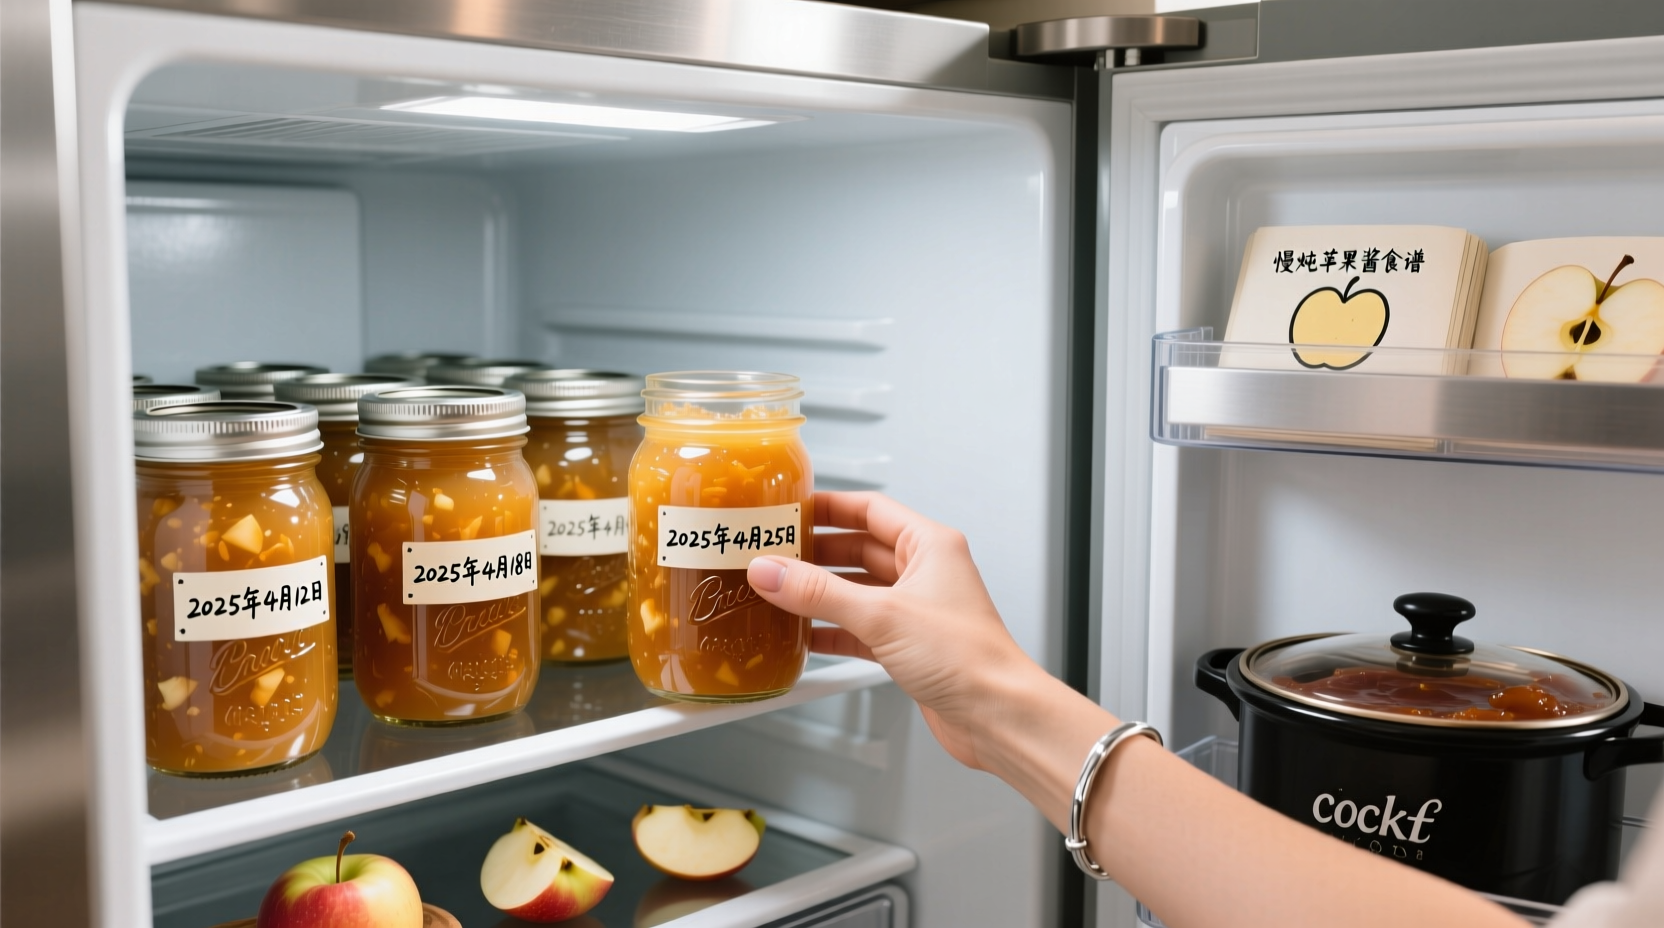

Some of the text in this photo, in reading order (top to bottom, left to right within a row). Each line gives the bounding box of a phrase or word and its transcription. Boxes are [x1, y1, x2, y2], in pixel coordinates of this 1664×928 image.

[1273, 247, 1425, 273] 慢炖苹果酱食谱
[547, 513, 629, 540] 2025年4月
[666, 523, 795, 555] 2025年4月25日
[413, 551, 532, 586] 2025年4月18日
[187, 580, 322, 619] 2025年4月12日
